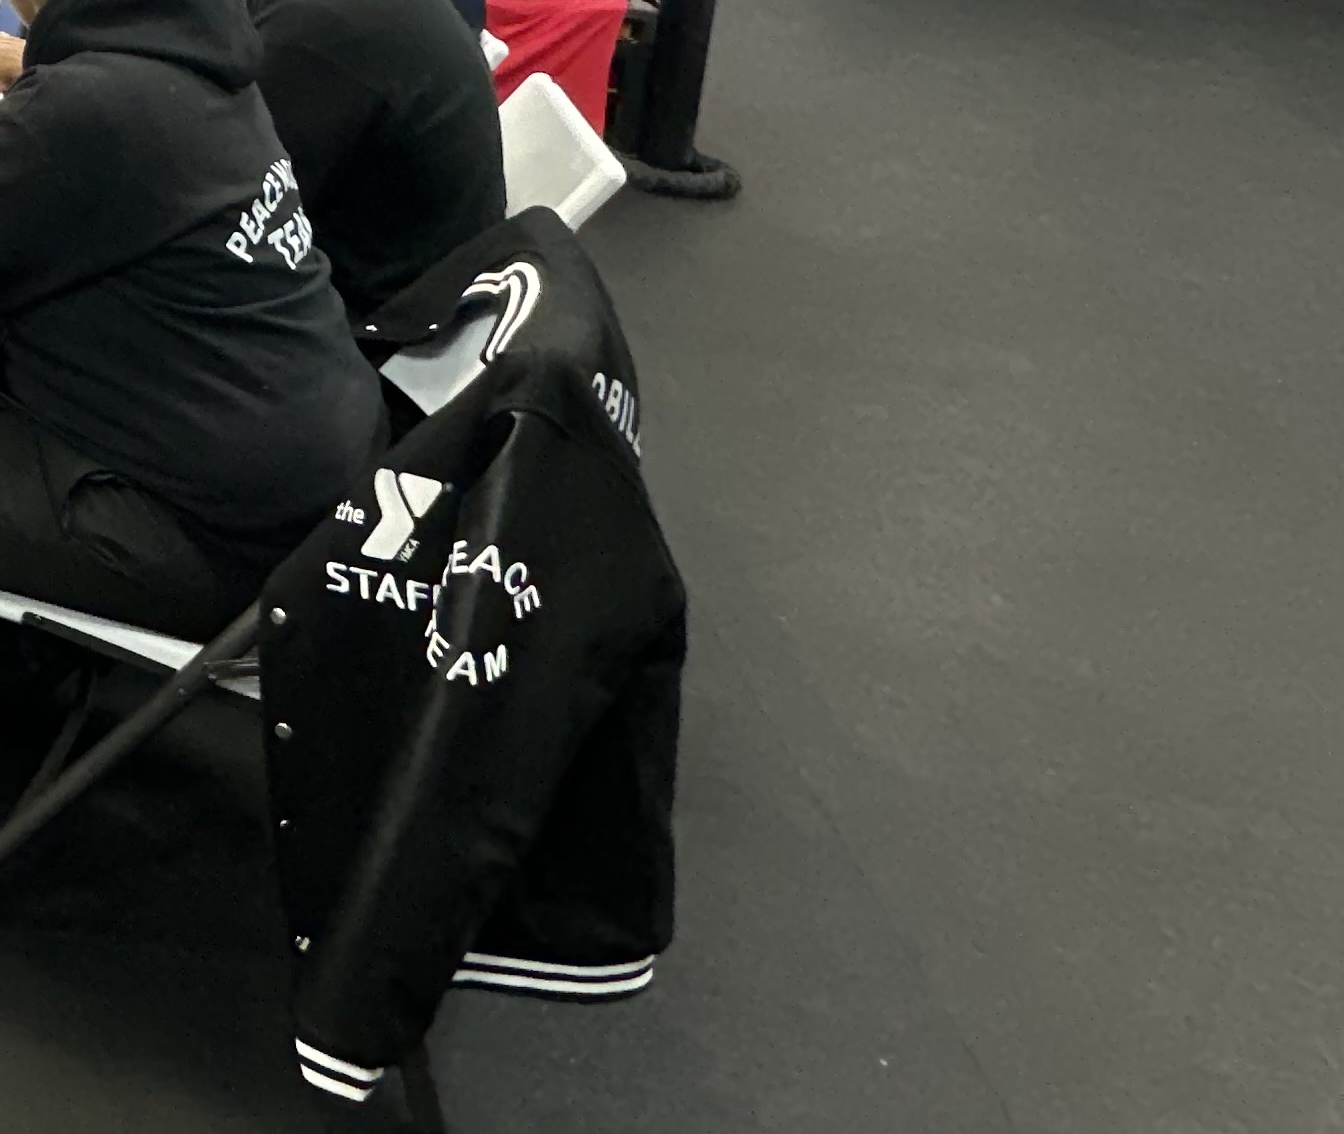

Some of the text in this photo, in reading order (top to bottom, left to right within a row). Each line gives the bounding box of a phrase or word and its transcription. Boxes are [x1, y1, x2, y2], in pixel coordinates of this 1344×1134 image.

[334, 499, 366, 525] the
[395, 537, 421, 564] YMCA
[441, 539, 542, 619] EACE
